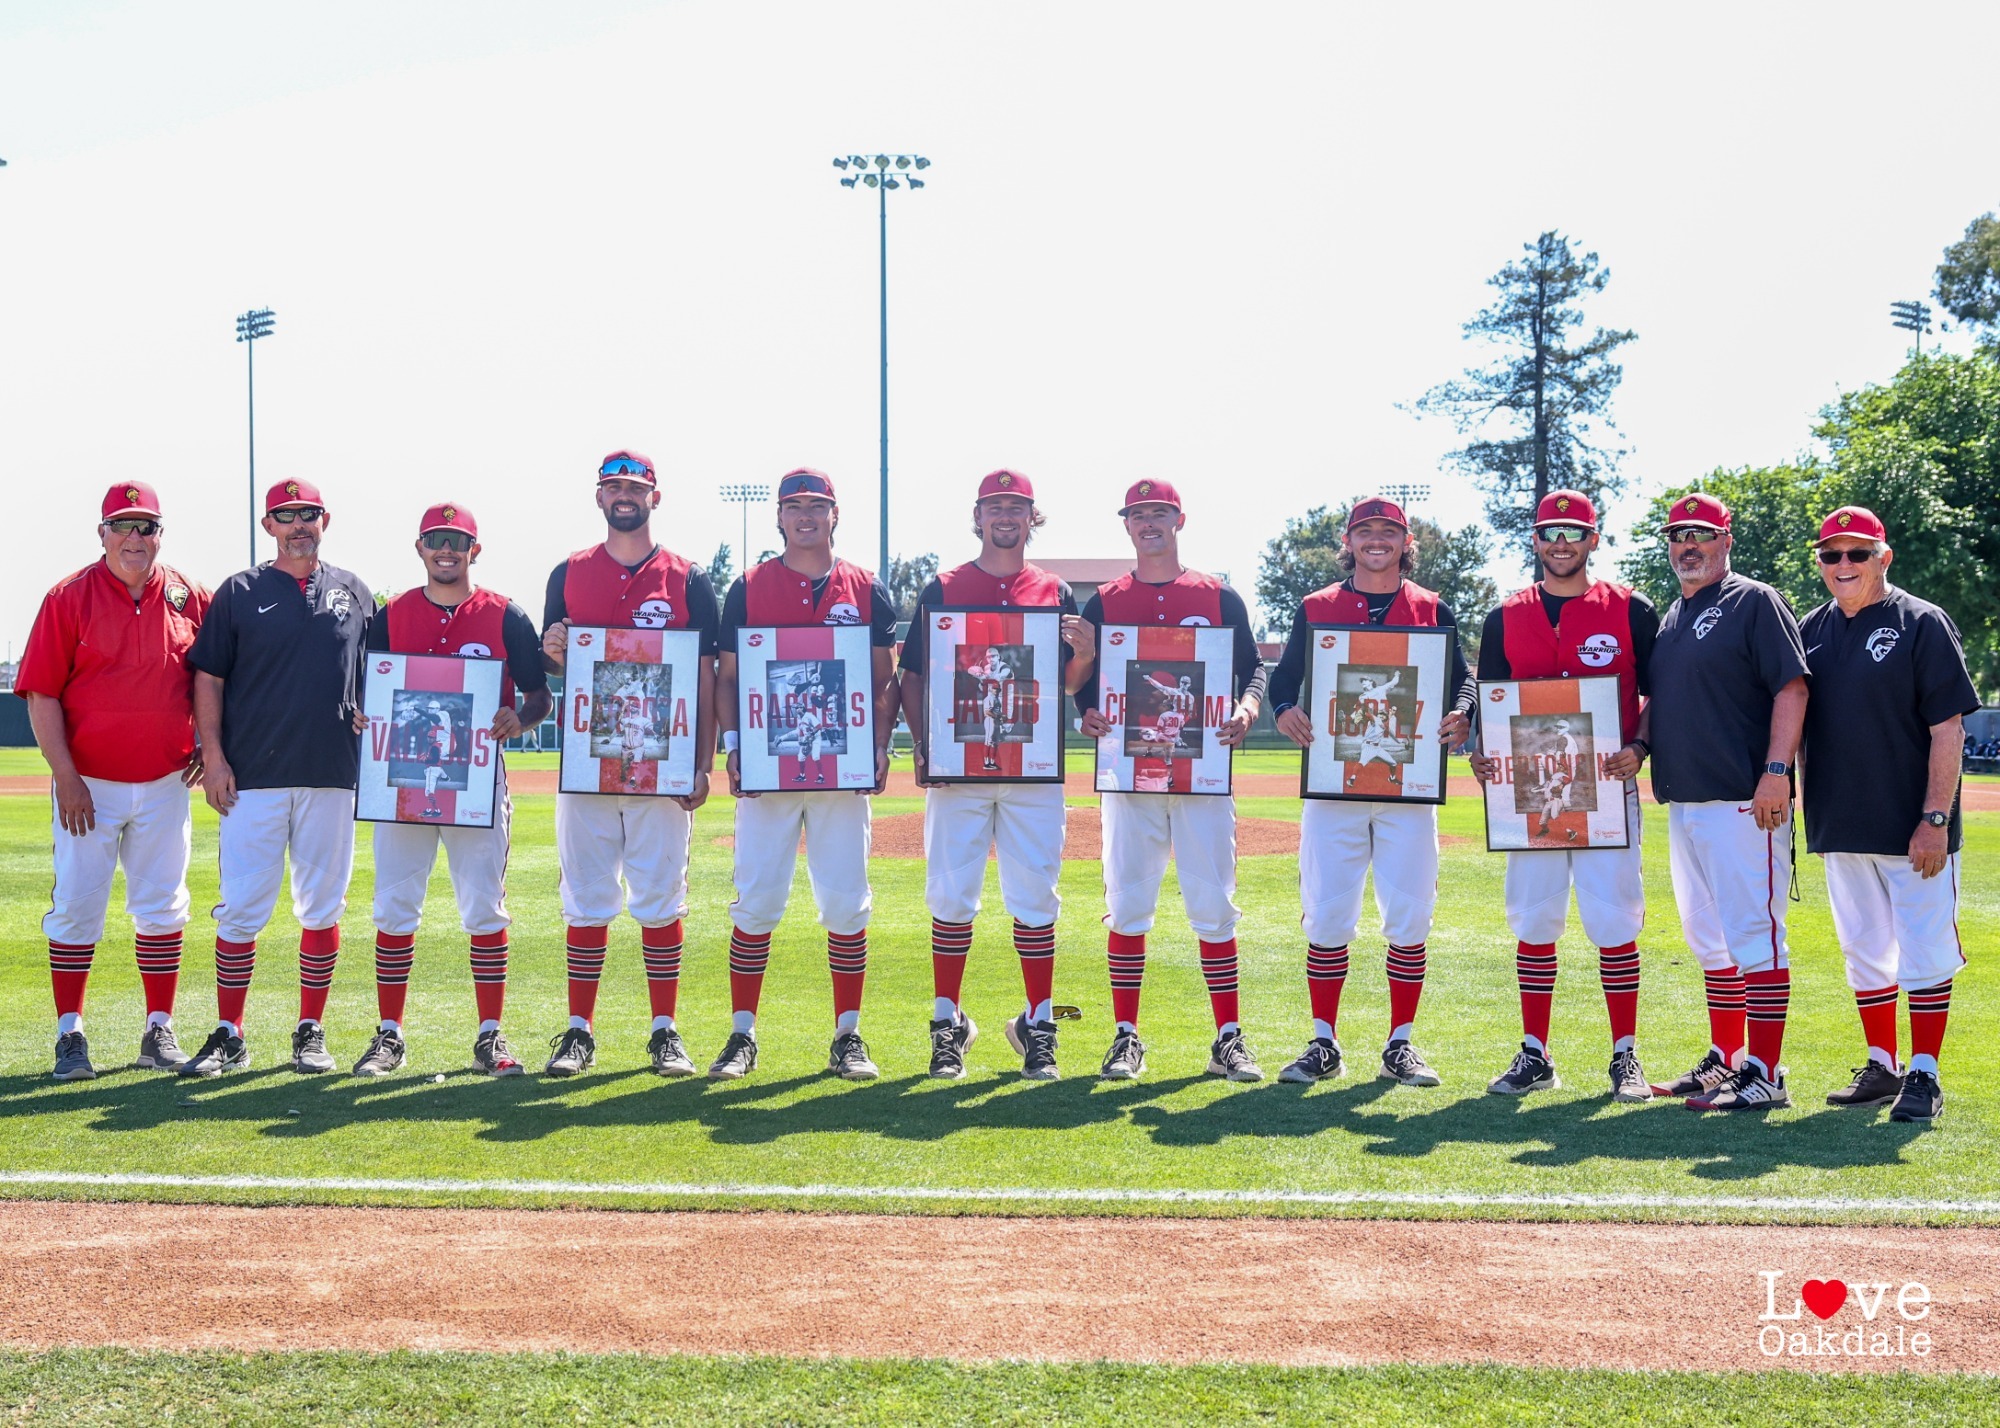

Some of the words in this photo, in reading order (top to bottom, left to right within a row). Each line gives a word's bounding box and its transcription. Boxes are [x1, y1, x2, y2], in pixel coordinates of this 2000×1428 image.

[632, 609, 676, 621] WARRIORS
[1576, 645, 1622, 656] WARRIORS
[1577, 633, 1619, 668] S
